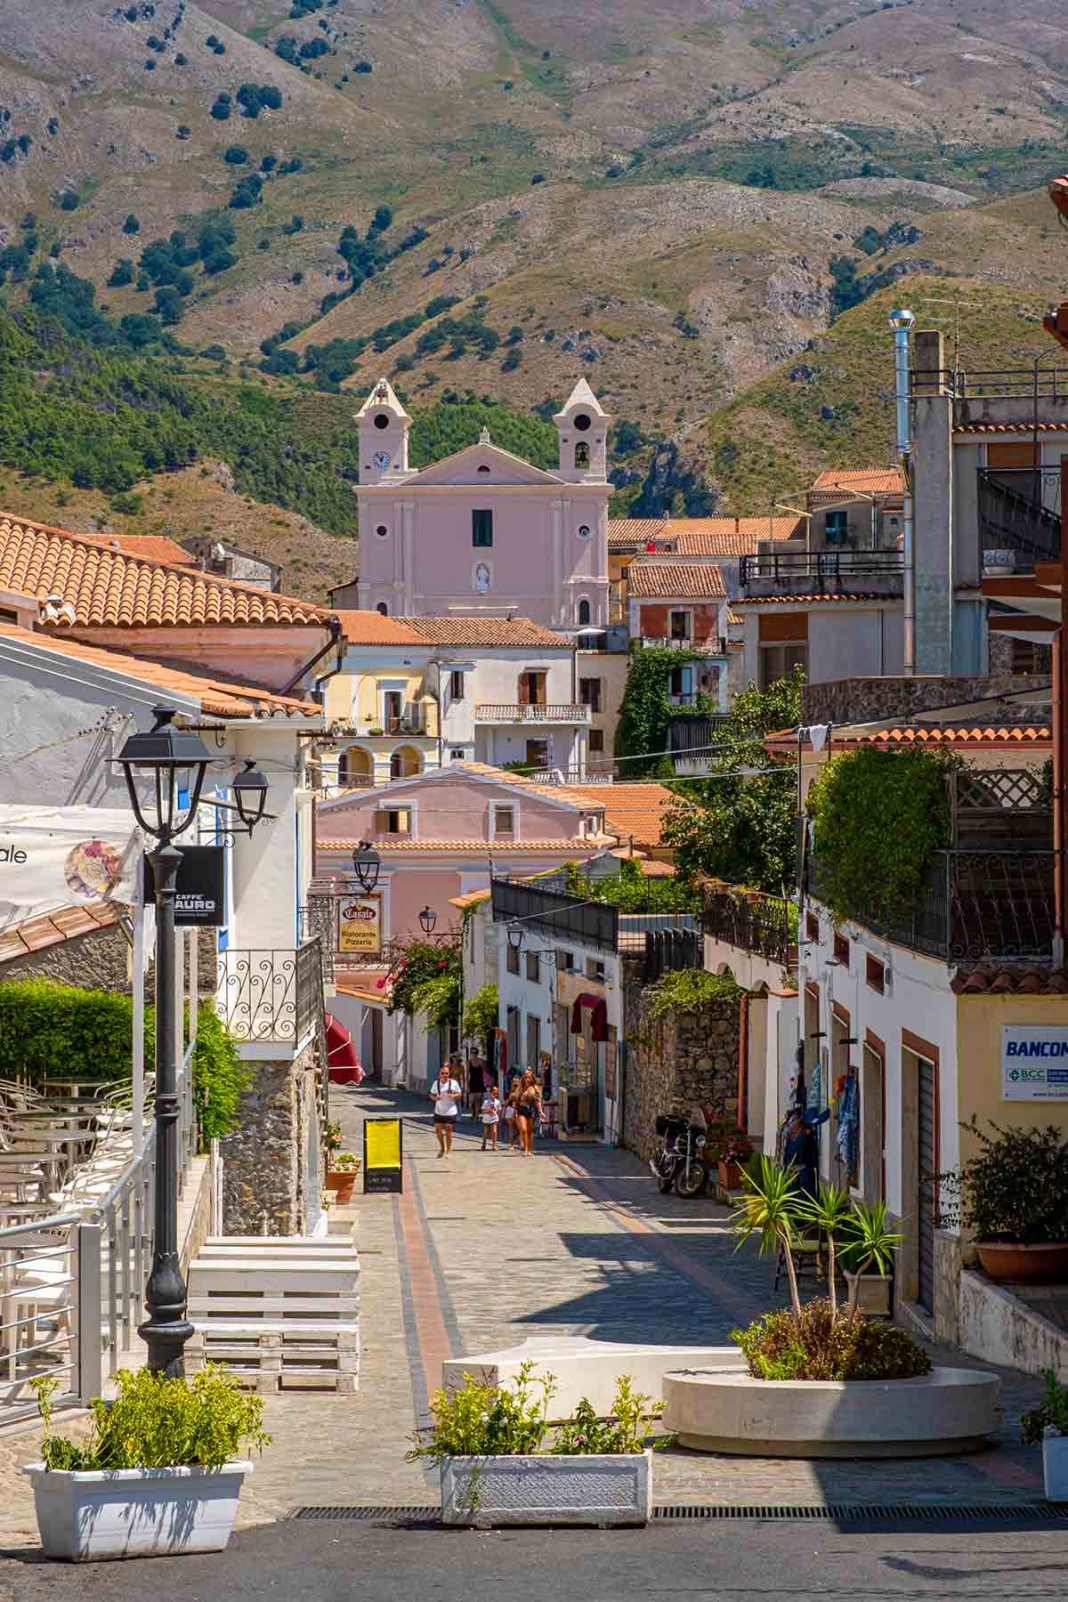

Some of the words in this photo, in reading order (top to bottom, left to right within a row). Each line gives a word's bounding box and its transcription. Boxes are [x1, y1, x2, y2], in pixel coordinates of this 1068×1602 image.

[174, 900, 215, 909] AURO
[344, 909, 374, 919] Casale
[341, 930, 376, 938] Ristorante
[345, 938, 372, 946] Pizzeria
[1021, 1070, 1046, 1078] BCC
